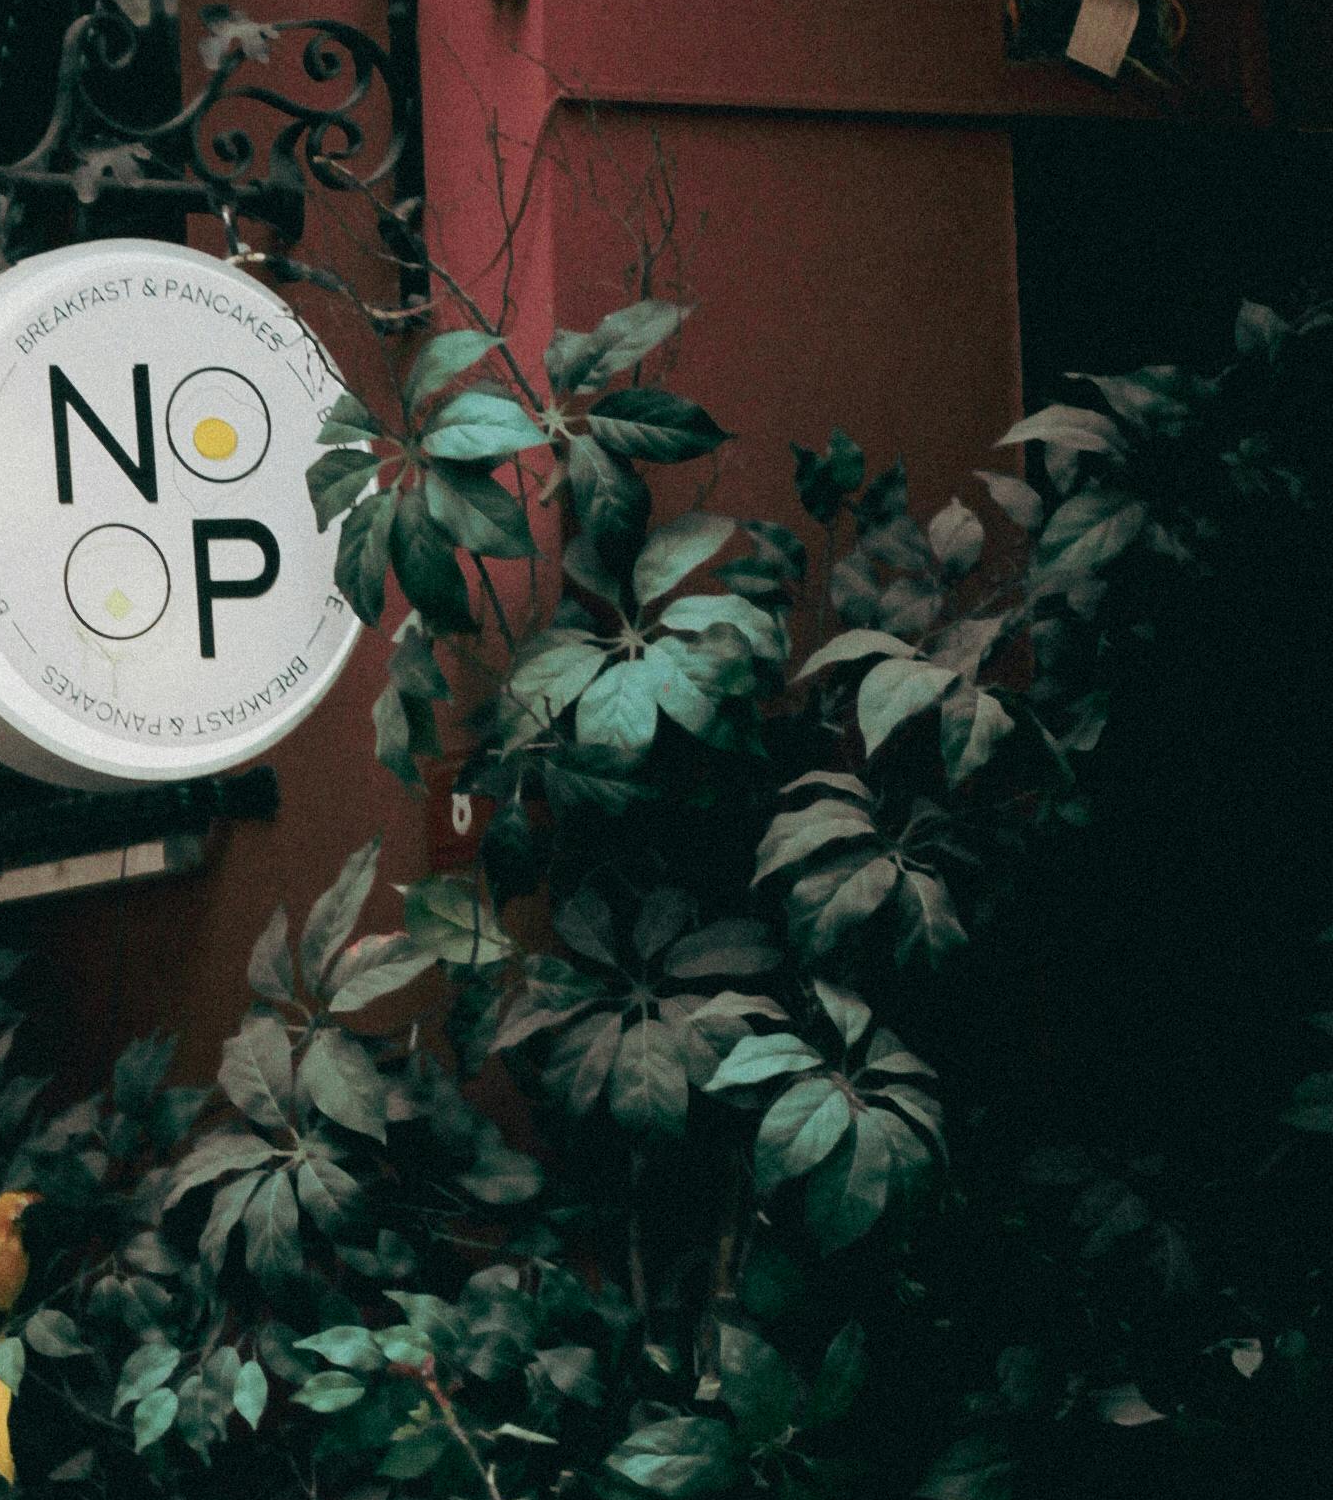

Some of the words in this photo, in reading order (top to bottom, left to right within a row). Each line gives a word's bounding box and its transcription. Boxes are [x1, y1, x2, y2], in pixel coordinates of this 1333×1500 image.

[15, 277, 133, 355] BREAKFAST
[141, 277, 158, 297] &
[165, 279, 287, 352] PANCAKES
[41, 664, 162, 737] PANCAKES
[170, 716, 184, 736] &
[193, 655, 309, 735] BREAKFAST
